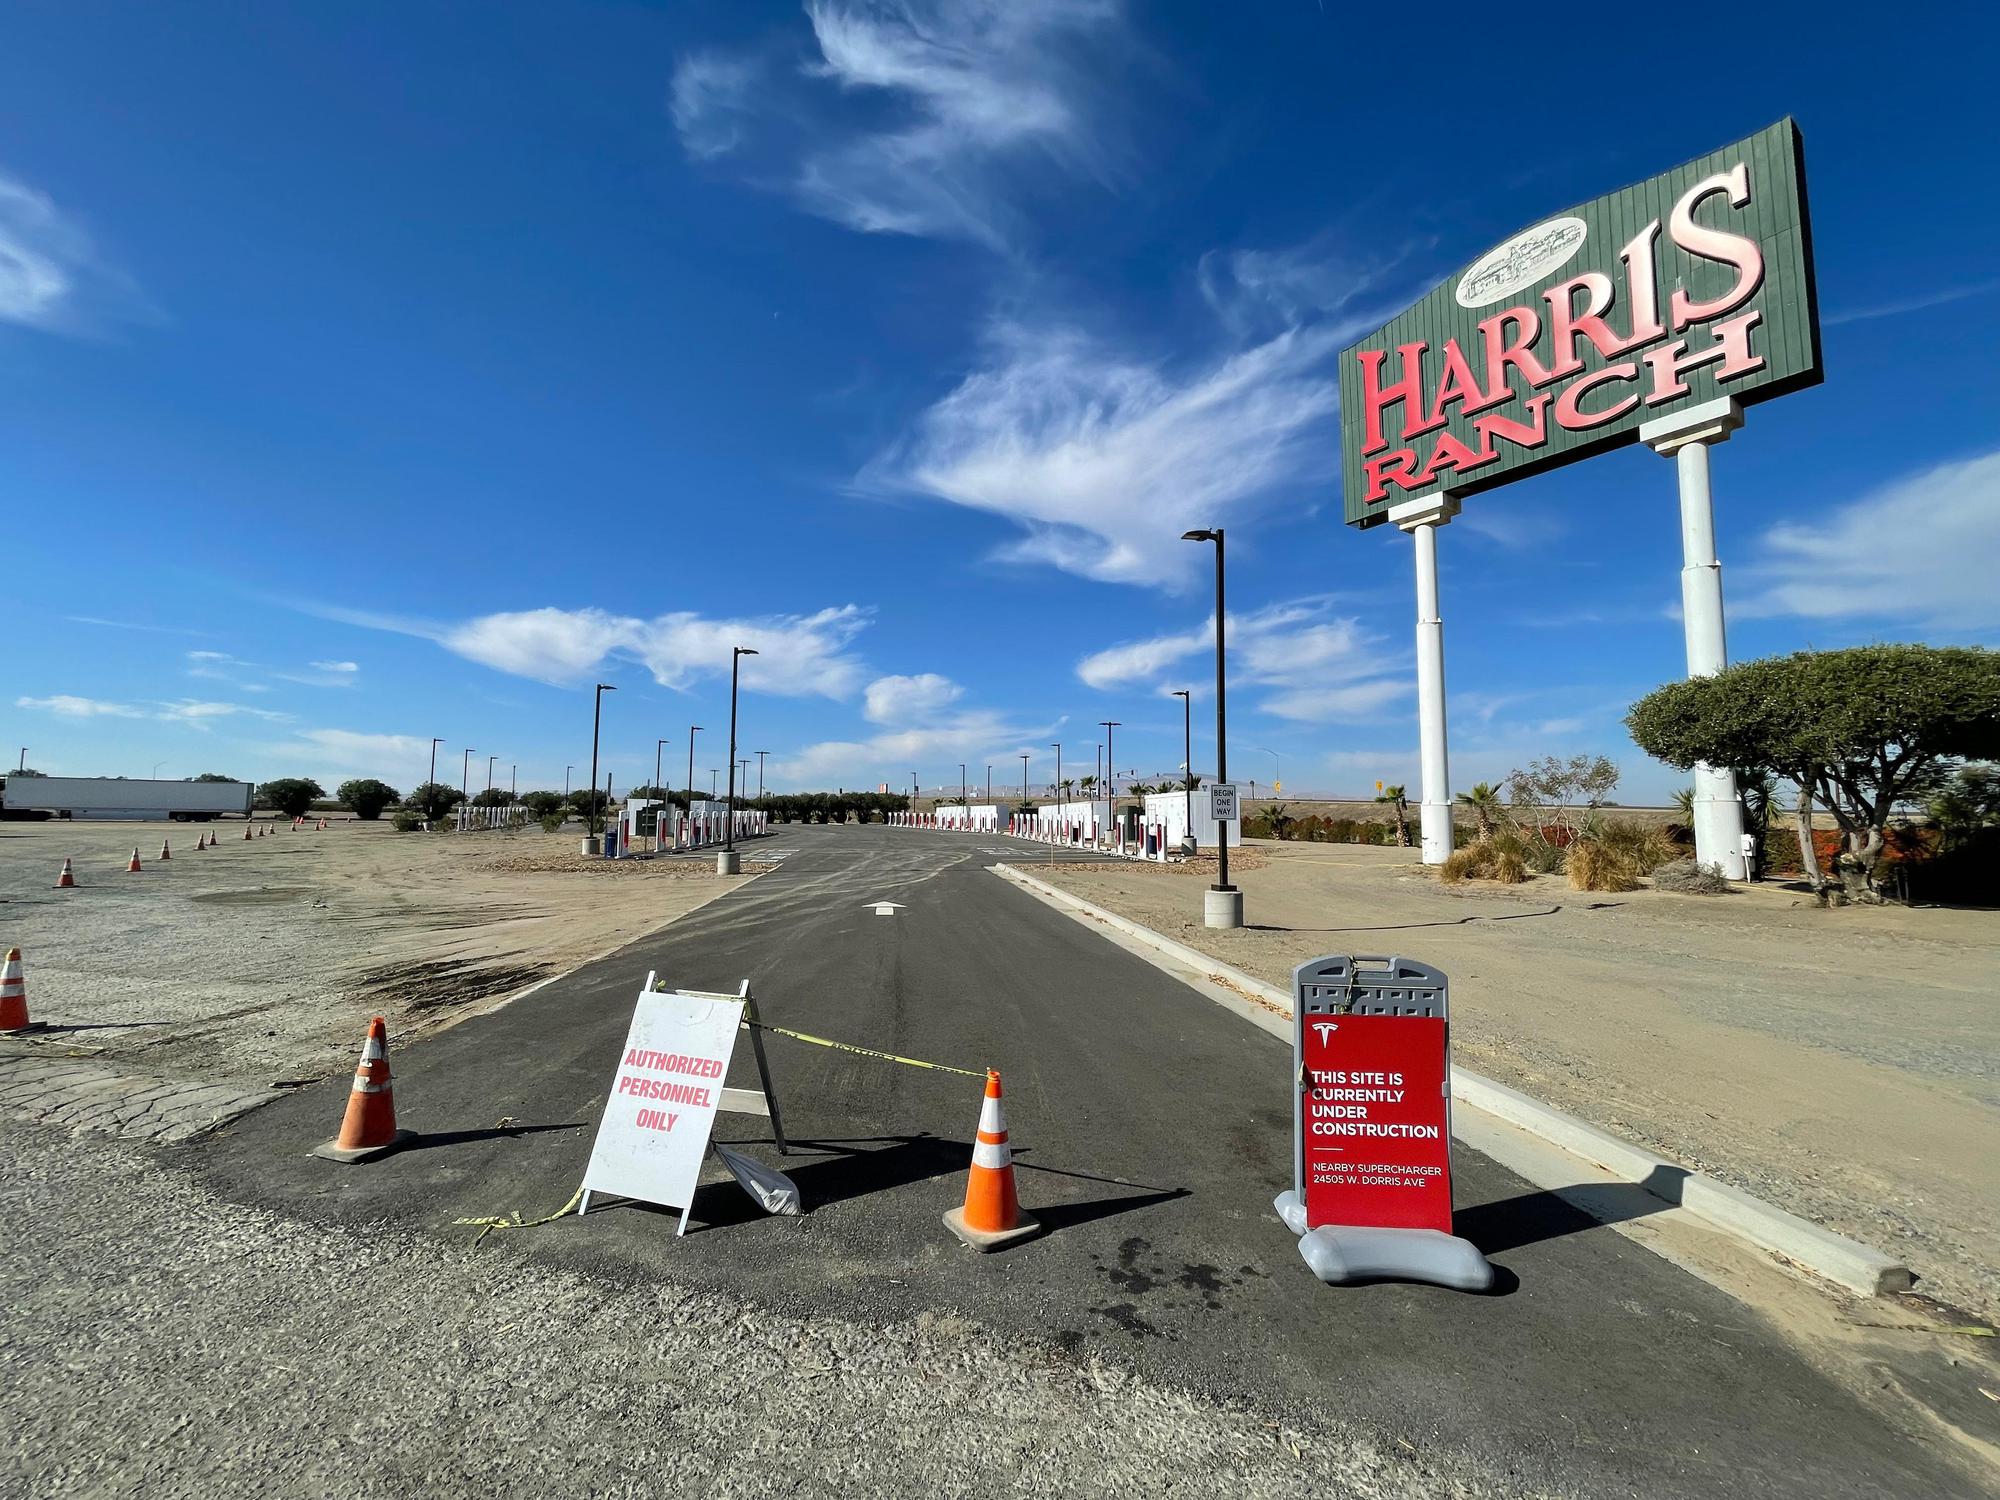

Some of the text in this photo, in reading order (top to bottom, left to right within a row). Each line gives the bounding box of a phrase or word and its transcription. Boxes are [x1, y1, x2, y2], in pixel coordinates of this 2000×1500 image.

[1357, 162, 1766, 455] HARRIS
[1363, 310, 1766, 504] RANCH
[1213, 789, 1234, 797] BEGIN
[624, 1049, 724, 1079] AUTHORIZED
[1311, 1071, 1403, 1086] THIS SITE IS
[618, 1076, 711, 1108] PERSONNEL
[1311, 1088, 1405, 1103] CURRENTLY
[1311, 1104, 1368, 1119] UNDER
[635, 1109, 679, 1133] ONLY
[1312, 1121, 1439, 1139] CONSTRUCTION
[1313, 1162, 1442, 1176] NEARBY SUPERCHARGER
[1313, 1174, 1426, 1188] 24505 W. DORRIS AVE
